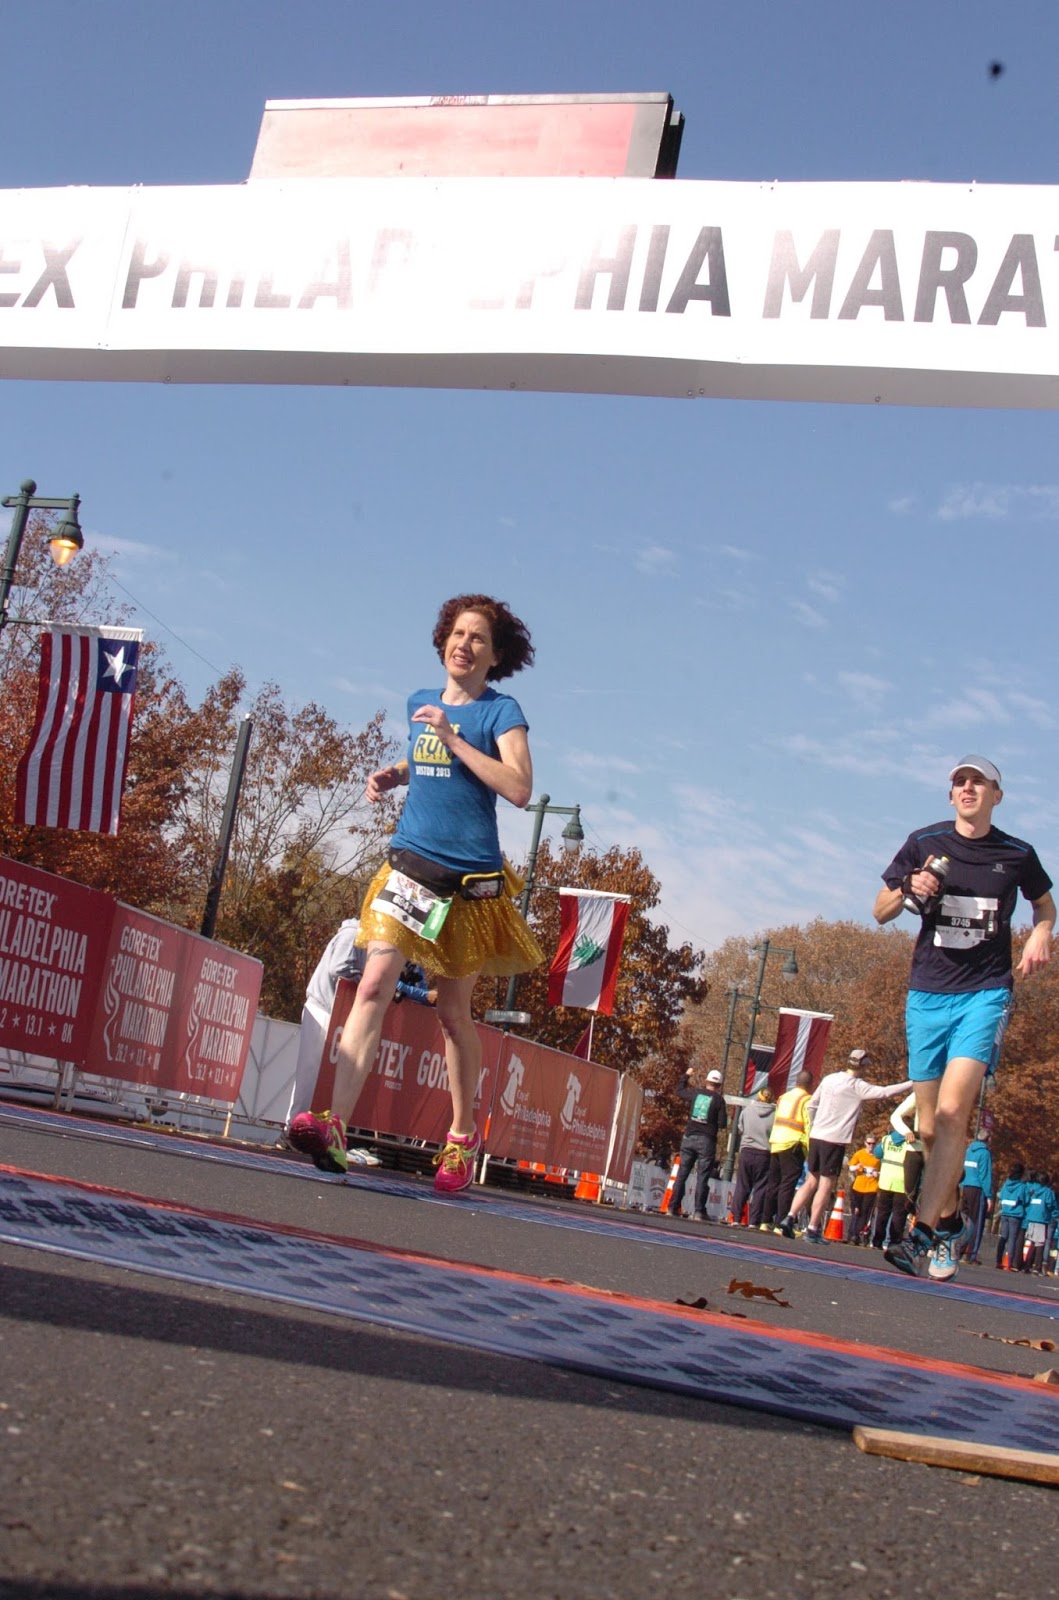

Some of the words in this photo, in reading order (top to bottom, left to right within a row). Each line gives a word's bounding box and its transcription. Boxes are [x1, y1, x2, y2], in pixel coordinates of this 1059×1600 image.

[761, 228, 1059, 329] MARA
[120, 925, 162, 963] GORE-TEX
[113, 953, 176, 1009] PHILADELPHIA
[200, 956, 238, 990] GORE-TEX
[120, 1000, 169, 1048] MARATHON
[194, 982, 250, 1032] PHILADELPHIA
[25, 1014, 43, 1037] 13.1
[61, 1022, 74, 1044] 8K
[199, 1024, 244, 1067] MARATHON
[513, 1103, 551, 1128] Philadelphia
